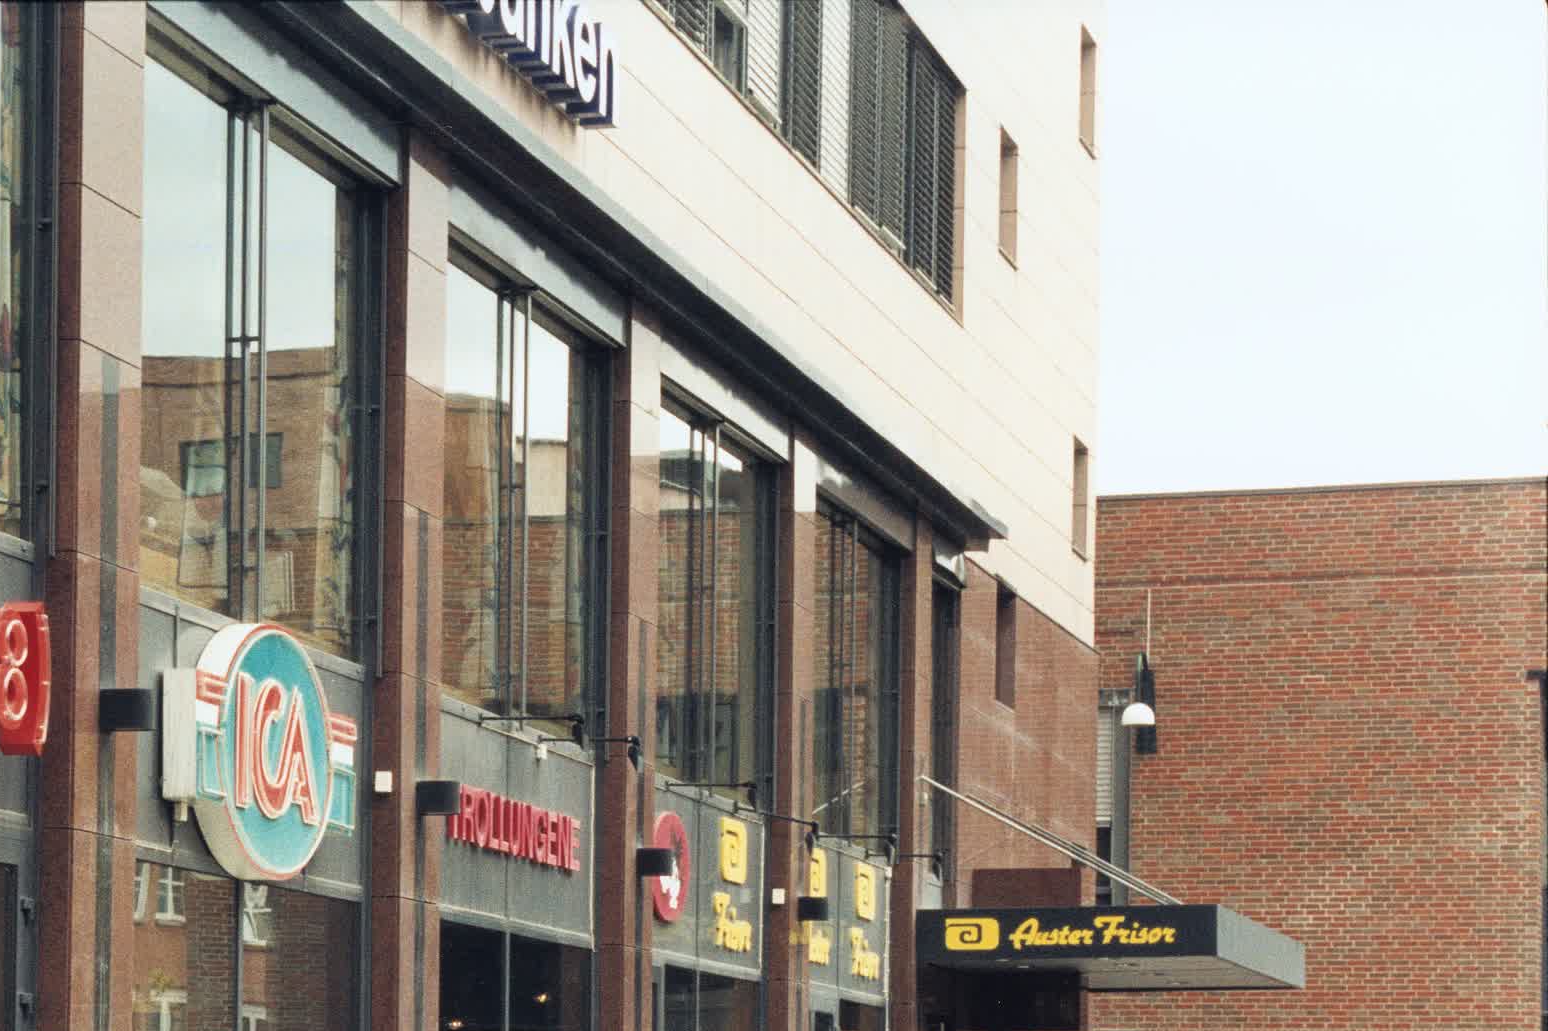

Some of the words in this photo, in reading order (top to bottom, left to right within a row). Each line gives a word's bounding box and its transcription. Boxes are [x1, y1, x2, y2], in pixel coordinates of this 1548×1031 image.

[480, 0, 620, 128] anken
[235, 671, 321, 826] ICA
[1008, 917, 1094, 950] Auster
